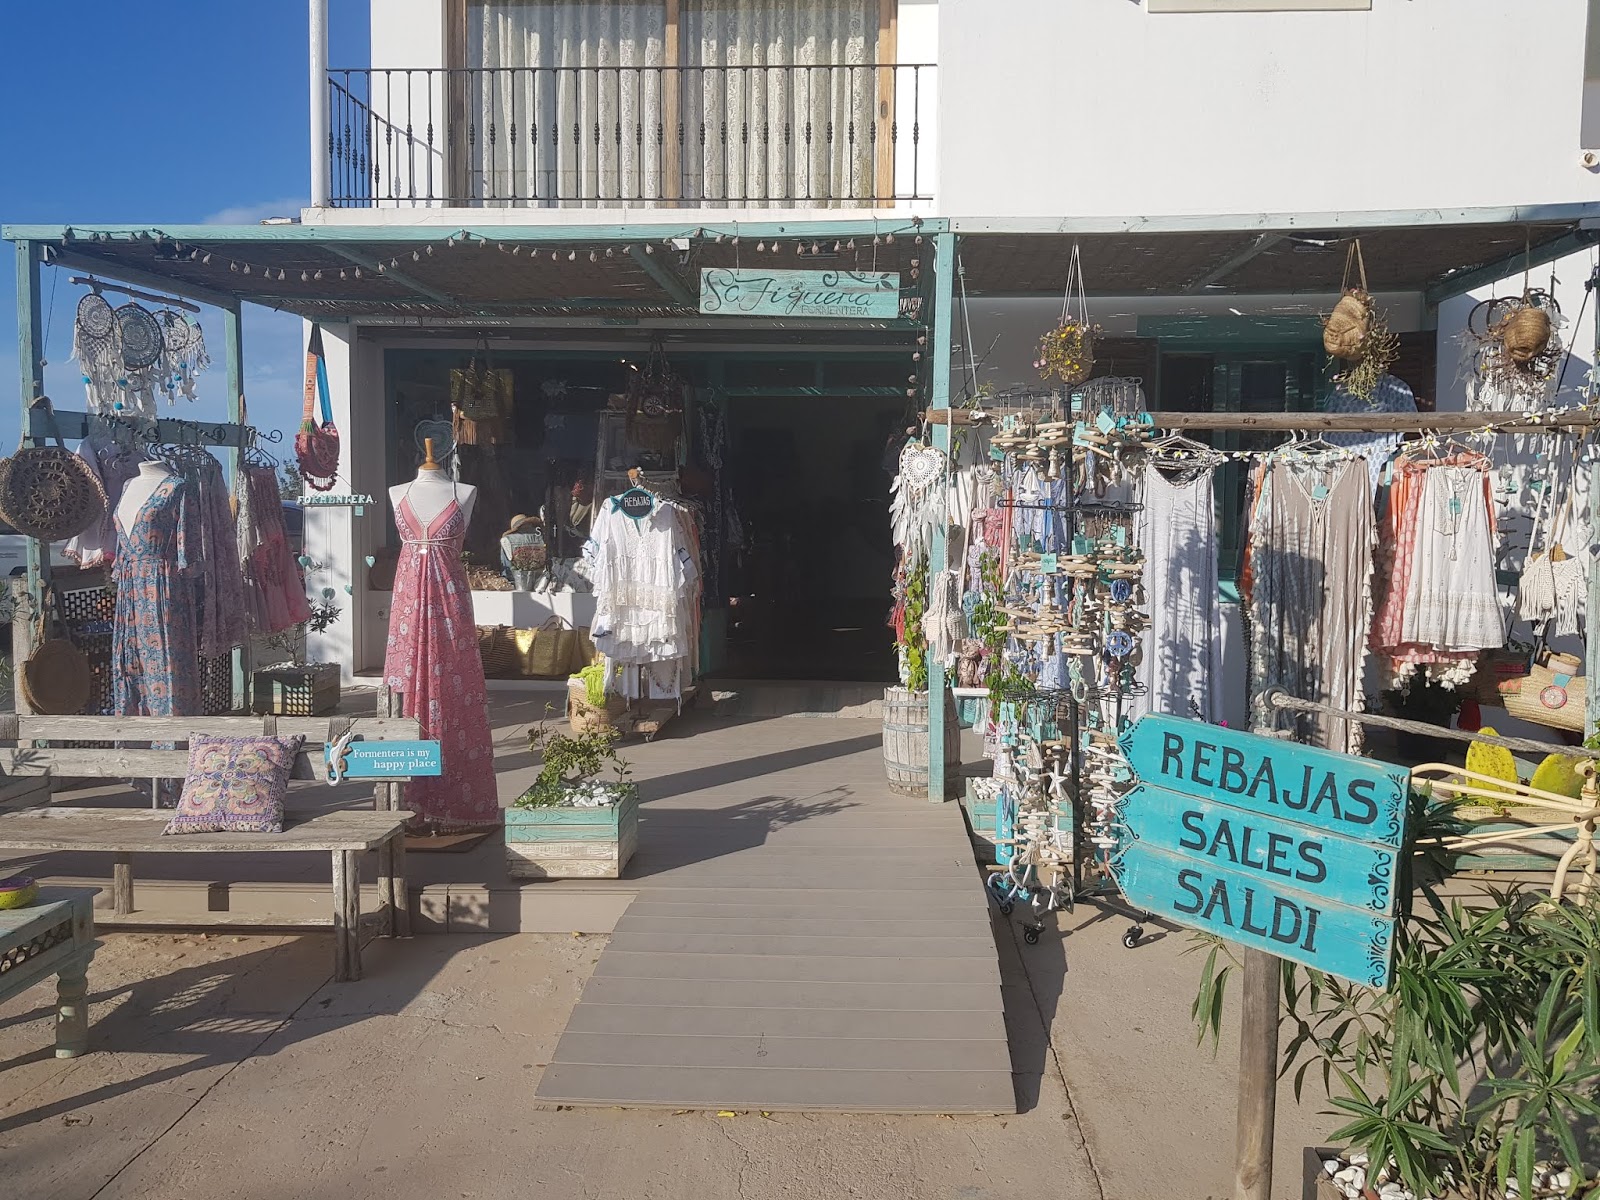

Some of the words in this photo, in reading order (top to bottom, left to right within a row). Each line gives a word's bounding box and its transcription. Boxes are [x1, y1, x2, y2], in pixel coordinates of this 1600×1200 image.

[704, 268, 745, 311] Sa
[735, 277, 874, 315] Figuera
[801, 304, 870, 316] FORMENTERA
[623, 496, 651, 507] REBAJAS
[353, 748, 405, 759] Formentera
[407, 748, 415, 757] is
[417, 749, 431, 760] my
[373, 759, 406, 771] happy
[408, 758, 437, 770] place
[1161, 731, 1378, 825] REBAJAS
[1179, 811, 1327, 883] SALES
[1173, 869, 1321, 953] SALDI
